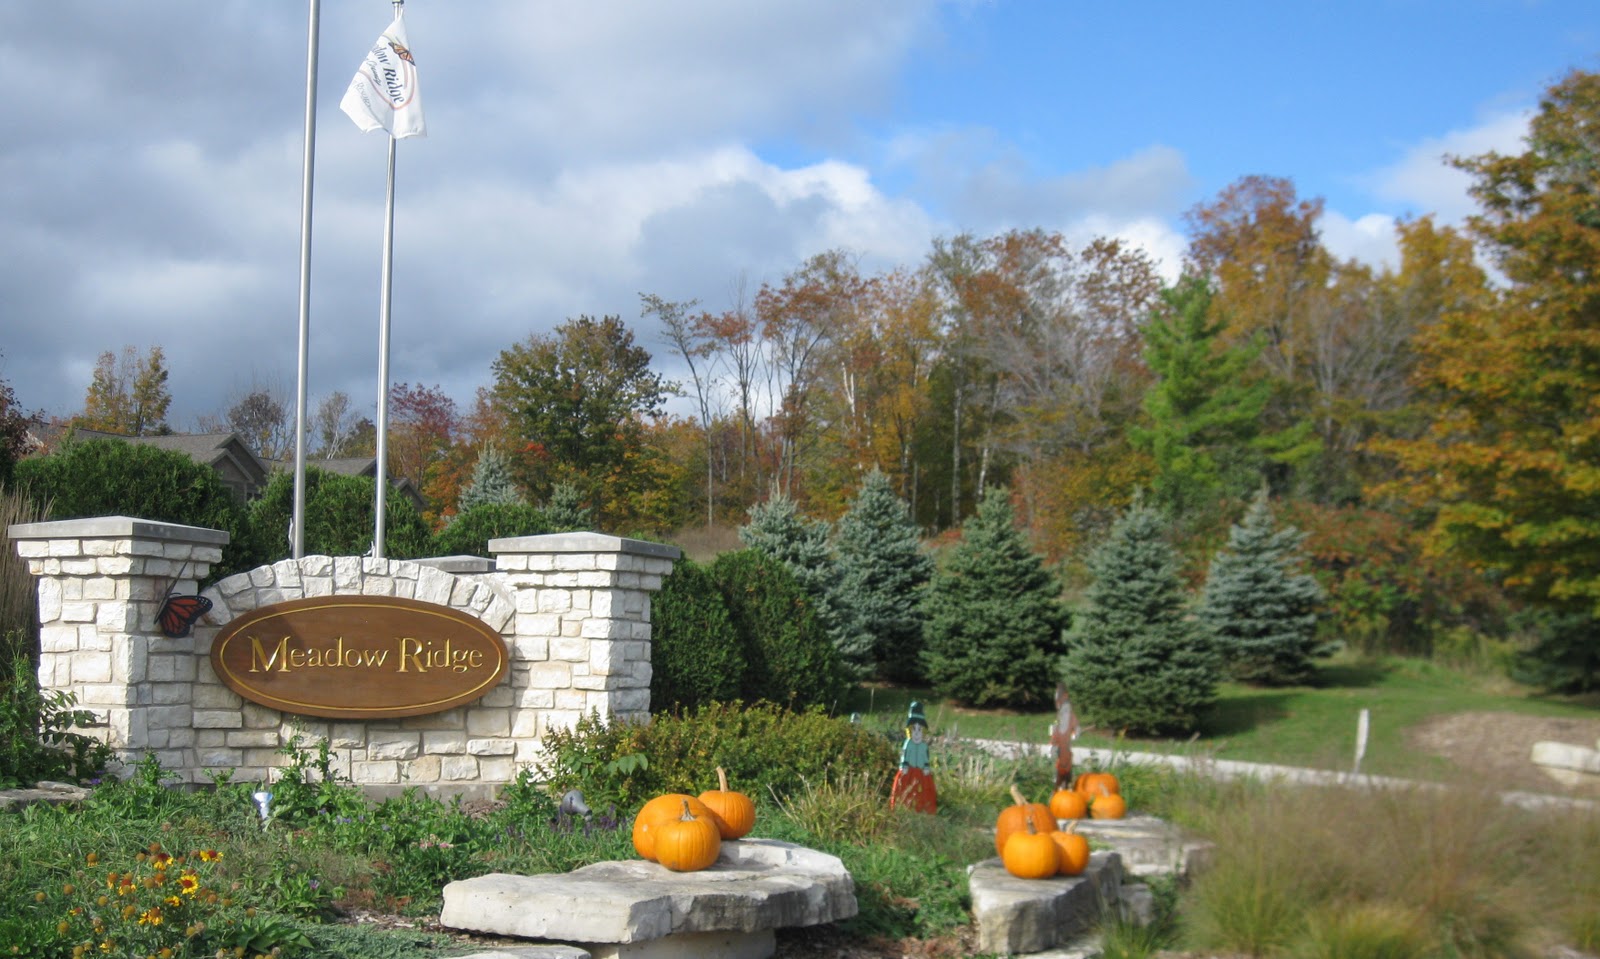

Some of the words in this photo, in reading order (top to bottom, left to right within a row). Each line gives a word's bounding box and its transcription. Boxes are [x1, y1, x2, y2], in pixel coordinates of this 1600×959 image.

[383, 67, 405, 105] Ridge
[247, 635, 389, 673] Meadow
[394, 636, 484, 673] Ridge
